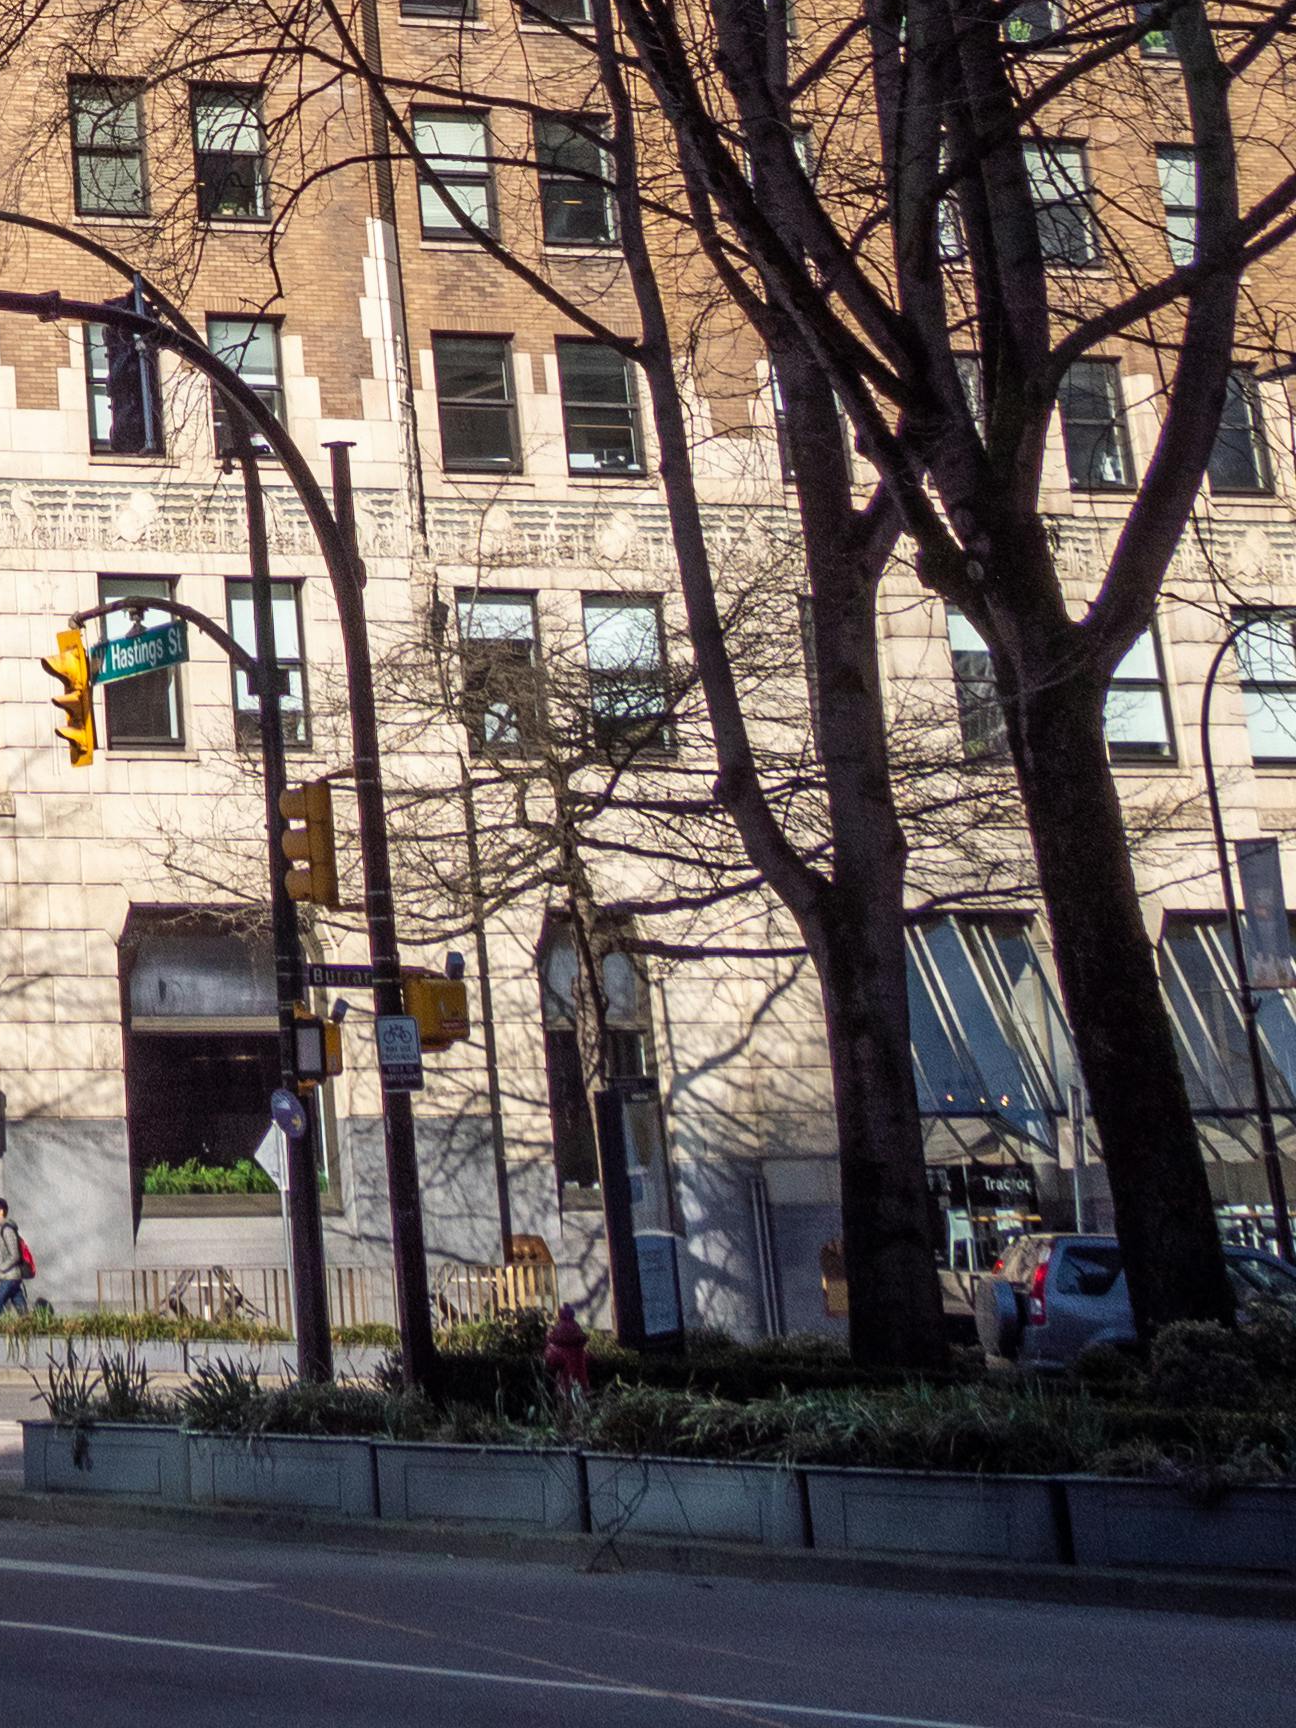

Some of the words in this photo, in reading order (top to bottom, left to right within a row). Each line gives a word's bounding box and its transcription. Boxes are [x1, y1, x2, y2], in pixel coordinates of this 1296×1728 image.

[111, 637, 164, 671] Hastings
[168, 627, 183, 656] St
[312, 968, 373, 984] Burrar
